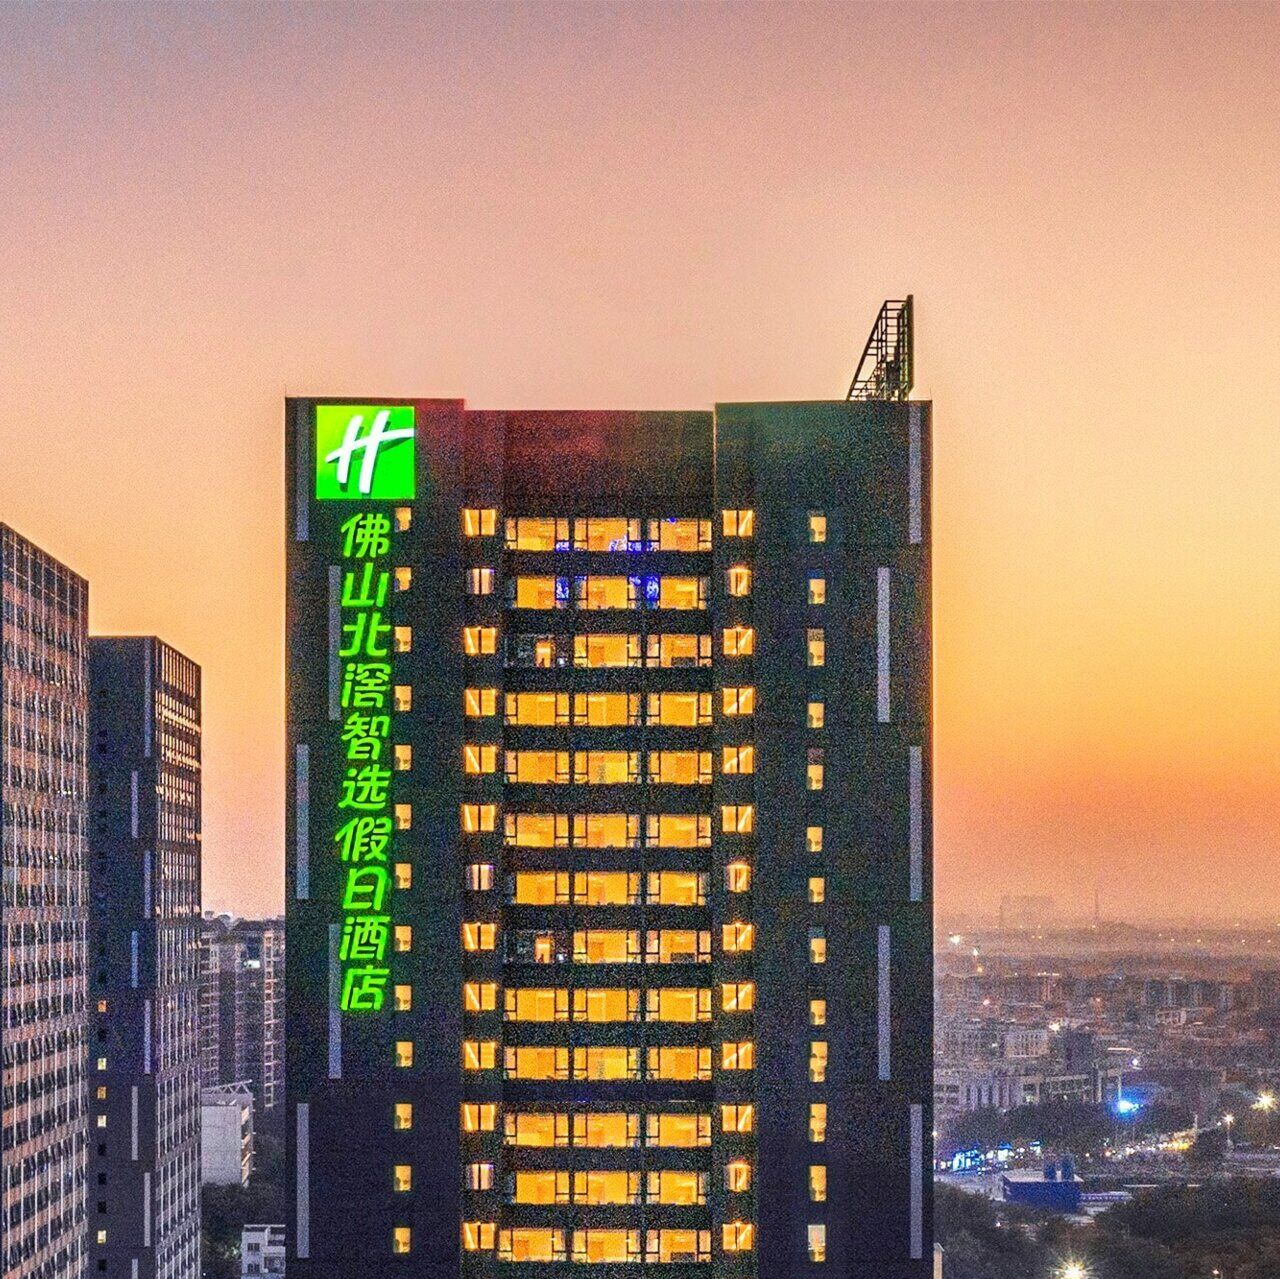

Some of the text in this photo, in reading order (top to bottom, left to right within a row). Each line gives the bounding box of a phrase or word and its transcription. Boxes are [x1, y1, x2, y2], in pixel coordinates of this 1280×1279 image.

[335, 512, 391, 1011] 佛山北滘智选假日酒店
